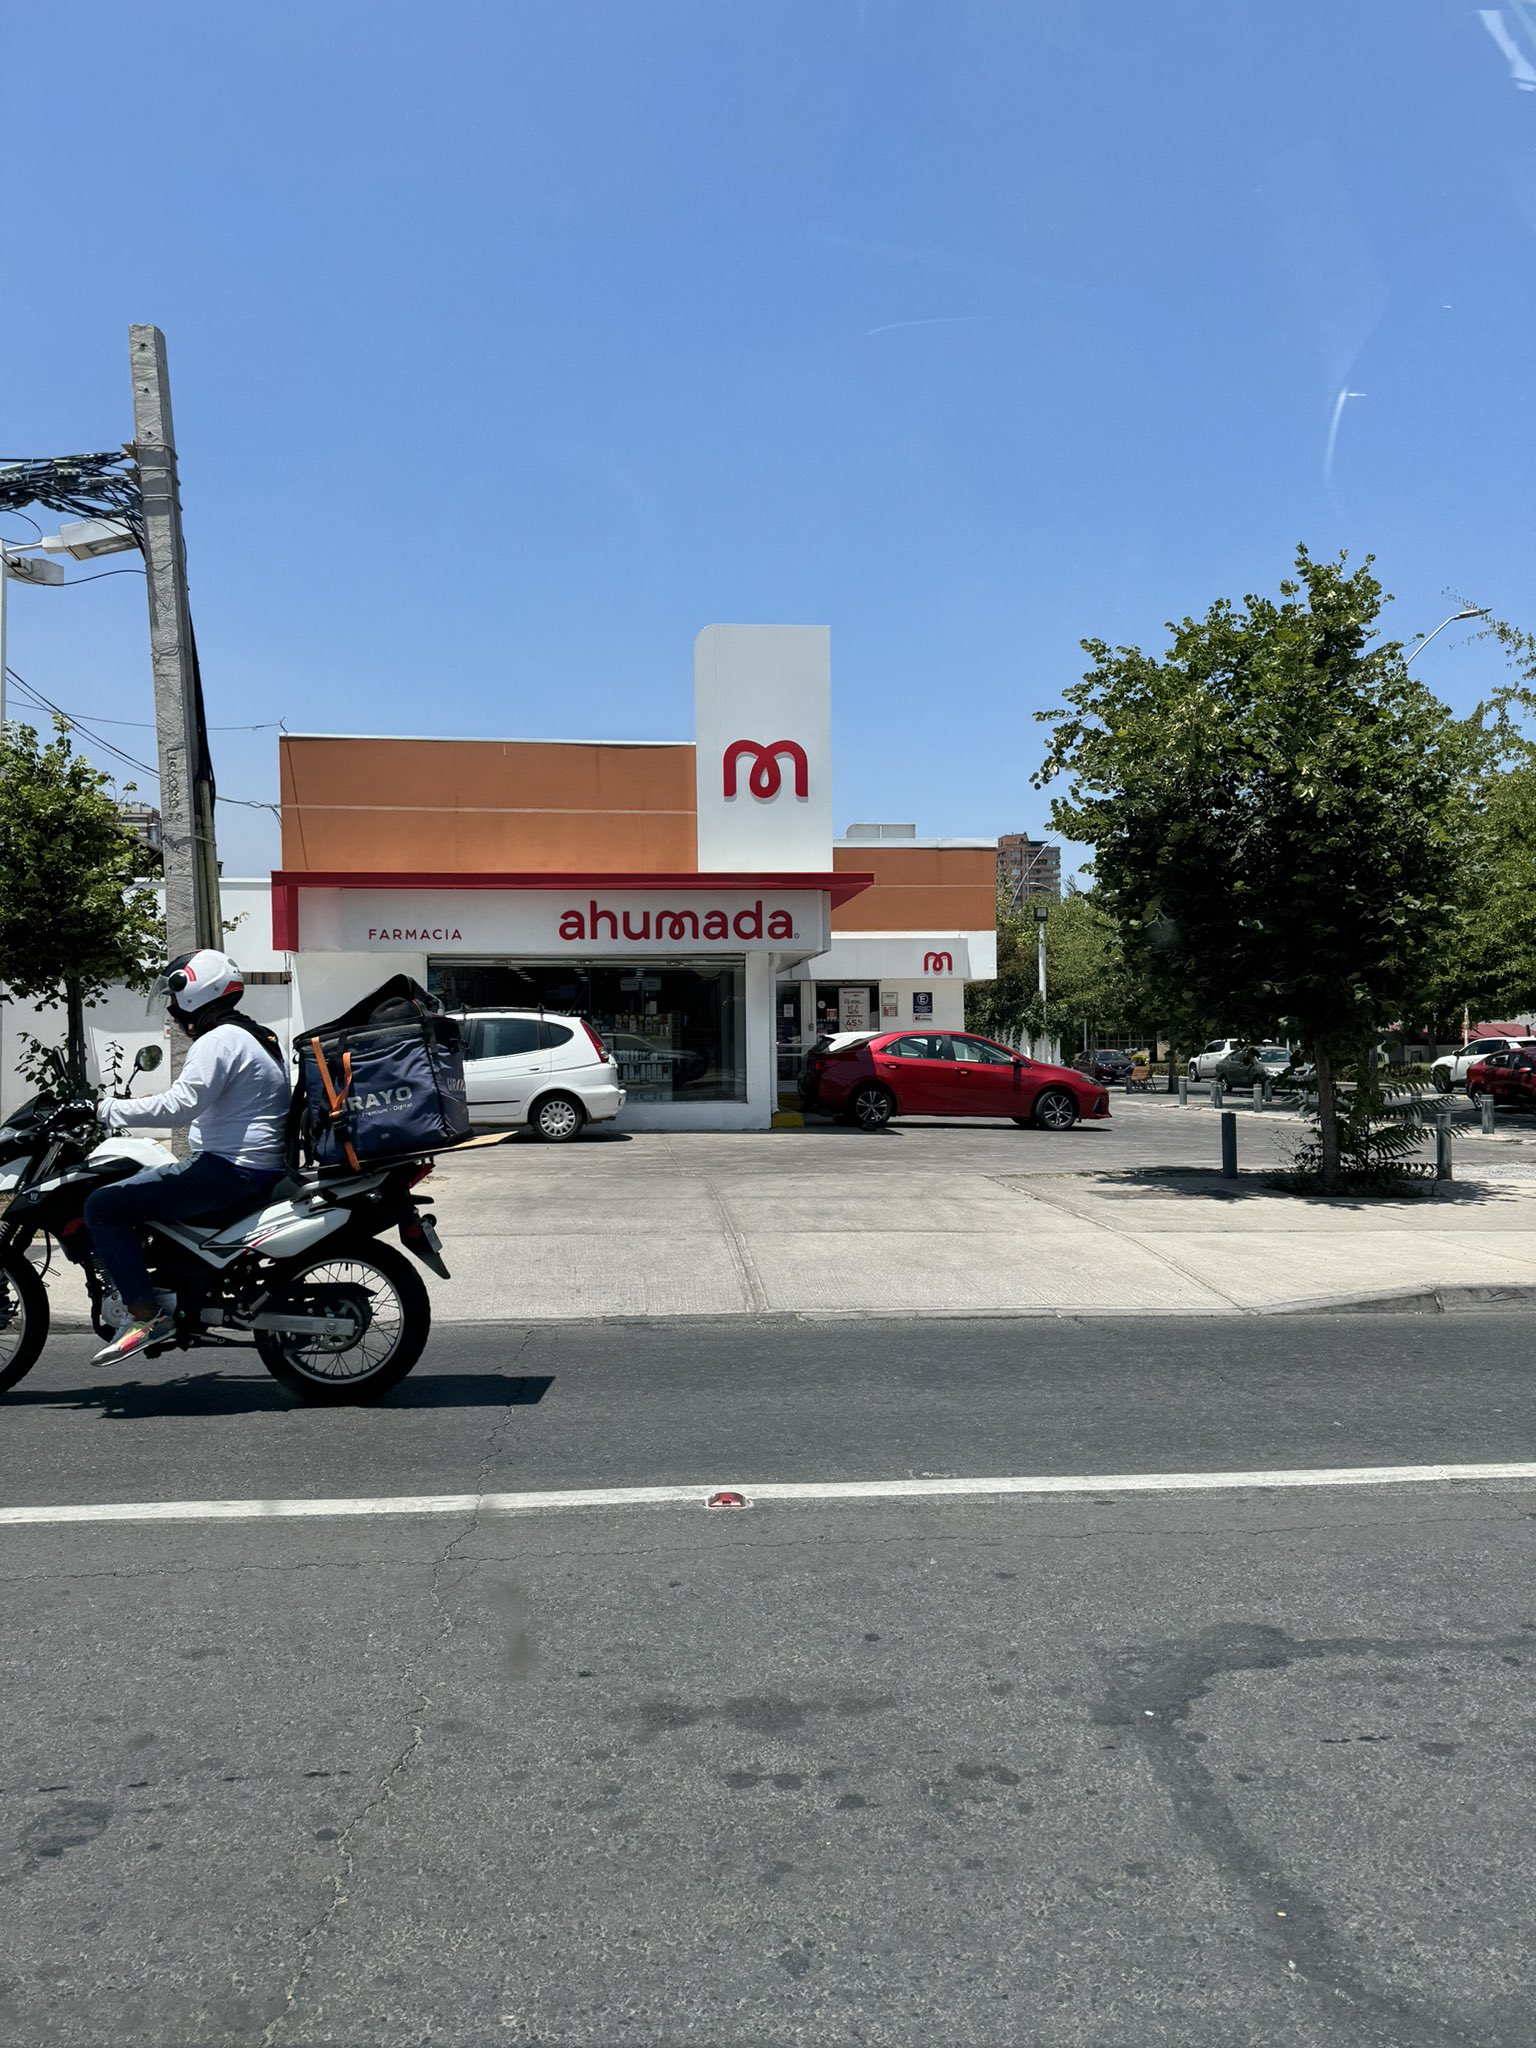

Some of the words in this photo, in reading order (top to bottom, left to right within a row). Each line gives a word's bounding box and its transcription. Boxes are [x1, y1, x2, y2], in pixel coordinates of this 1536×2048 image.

[558, 900, 793, 941] ahumada
[368, 928, 462, 940] FARMACIA
[919, 995, 926, 1003] E
[361, 1107, 388, 1118] Premium
[393, 1102, 413, 1112] Digital
